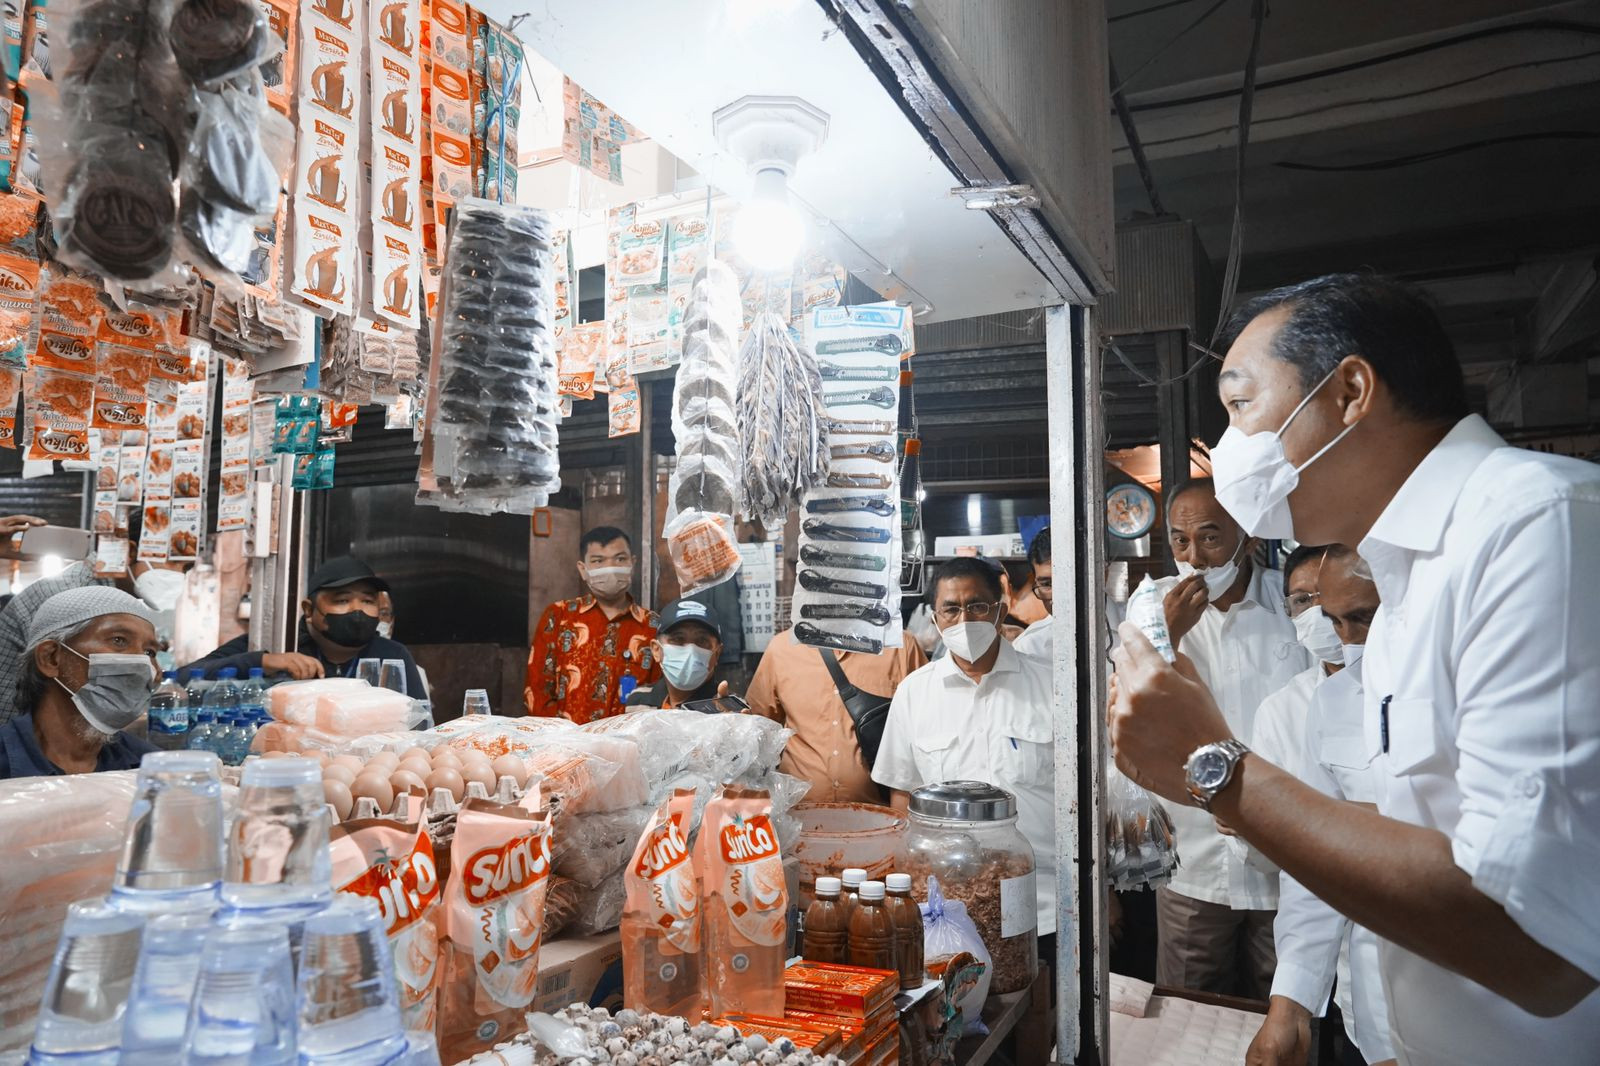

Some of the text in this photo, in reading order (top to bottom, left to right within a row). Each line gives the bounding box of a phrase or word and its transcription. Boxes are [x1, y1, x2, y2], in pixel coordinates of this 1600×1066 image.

[0, 273, 26, 291] iku
[109, 317, 150, 335] Sajiku
[48, 338, 90, 358] Sajiku
[158, 356, 187, 374] Sajiku
[102, 405, 143, 425] Sajiku
[42, 434, 86, 453] Sajiku
[728, 825, 774, 860] SunCo
